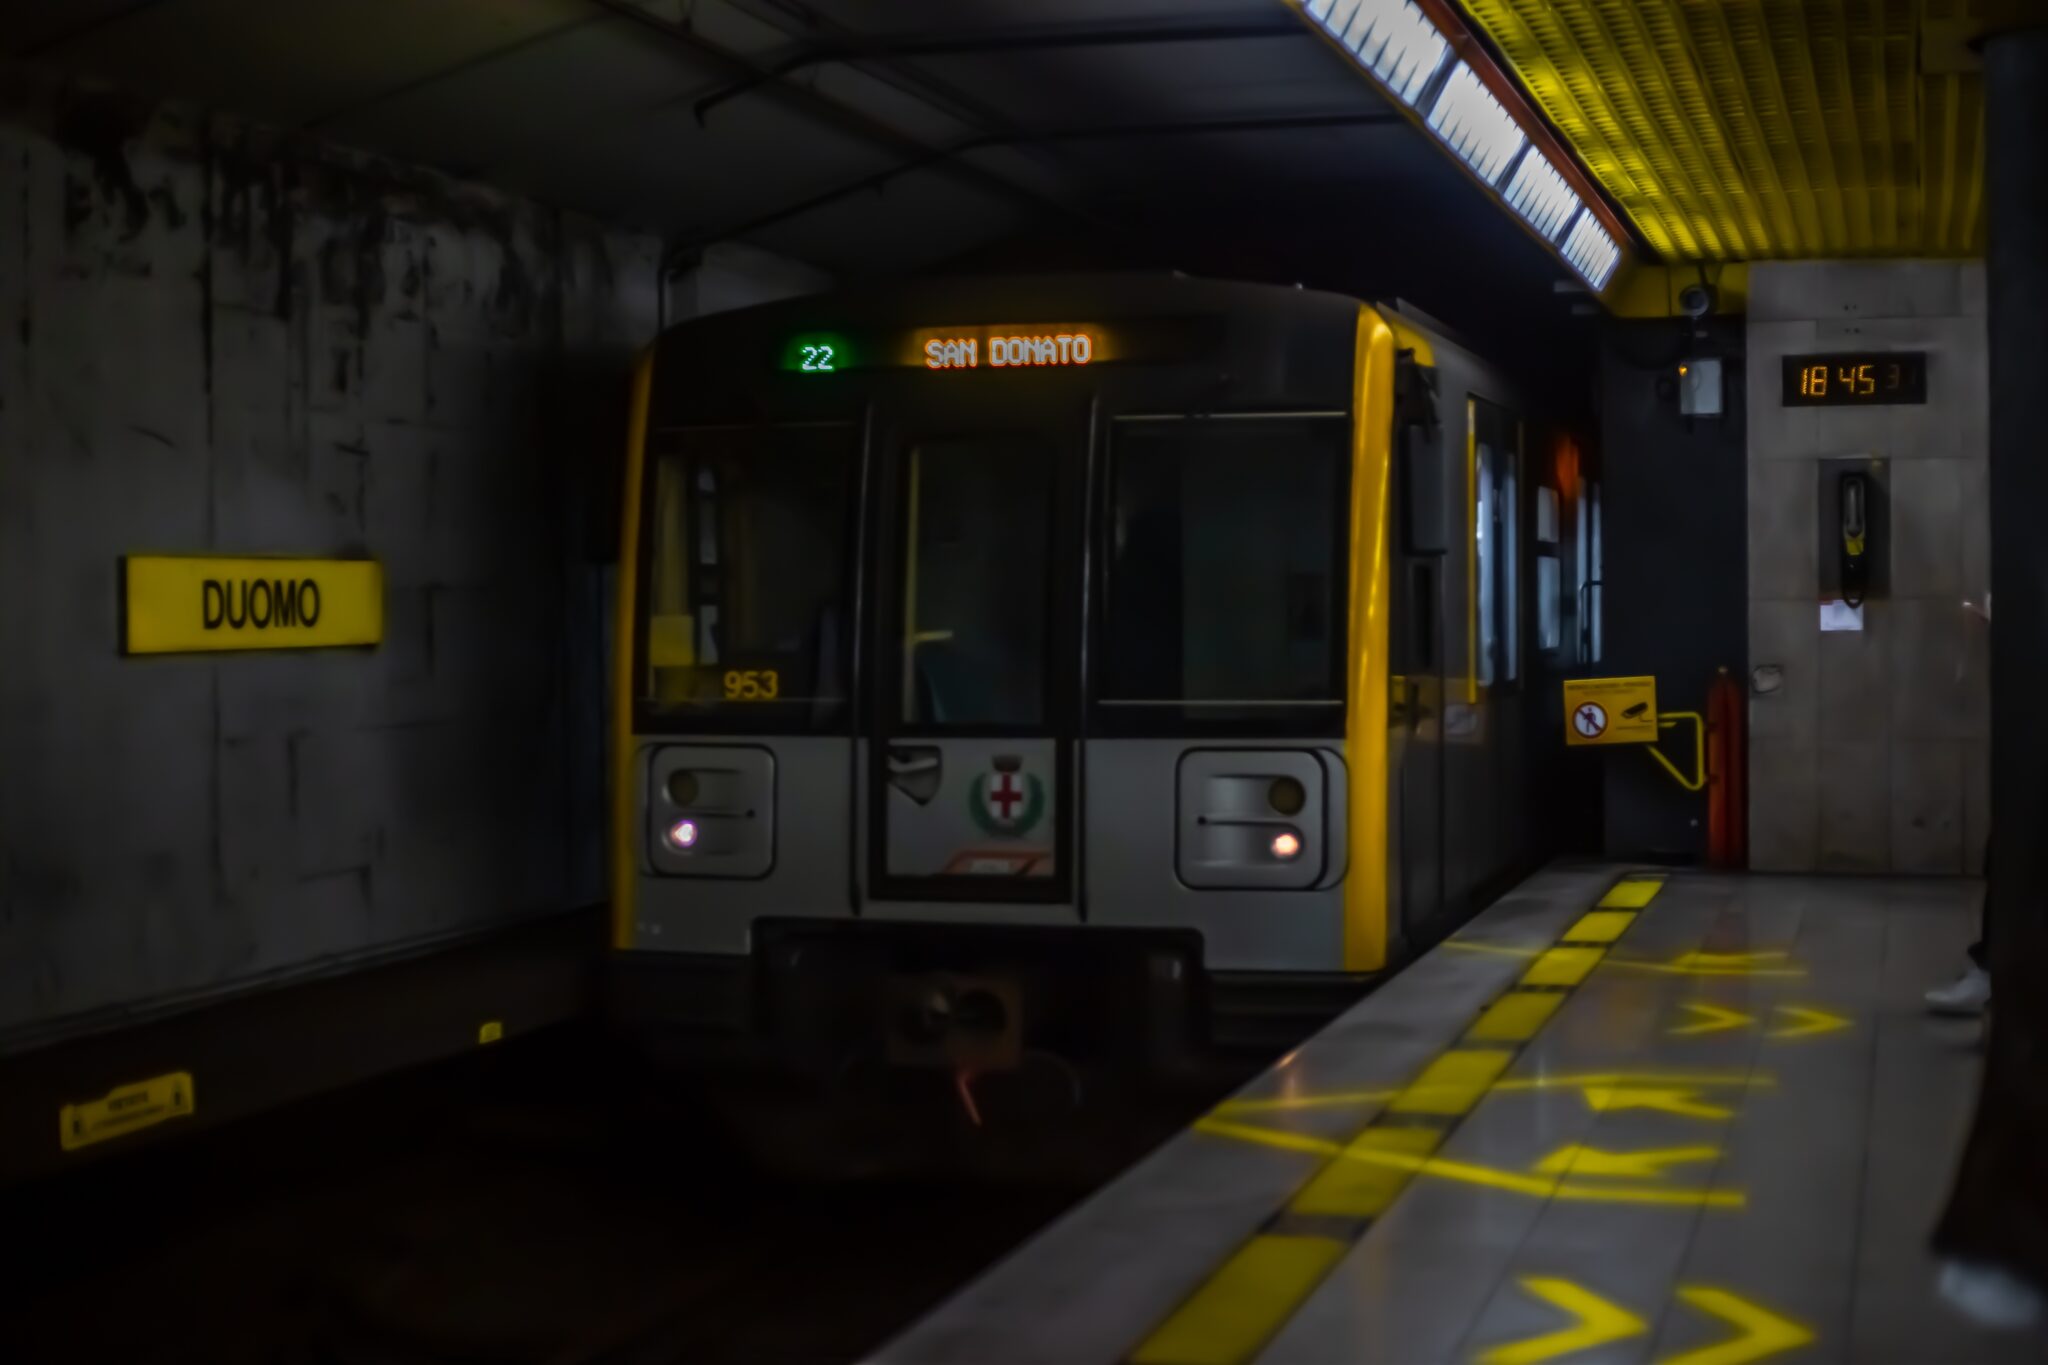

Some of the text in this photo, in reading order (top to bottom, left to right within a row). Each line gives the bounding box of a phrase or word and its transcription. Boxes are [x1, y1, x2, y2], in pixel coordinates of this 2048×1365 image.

[801, 346, 833, 370] 22
[925, 336, 1091, 367] SAN DONATO
[203, 579, 320, 629] DUOMO
[724, 670, 779, 700] 953
